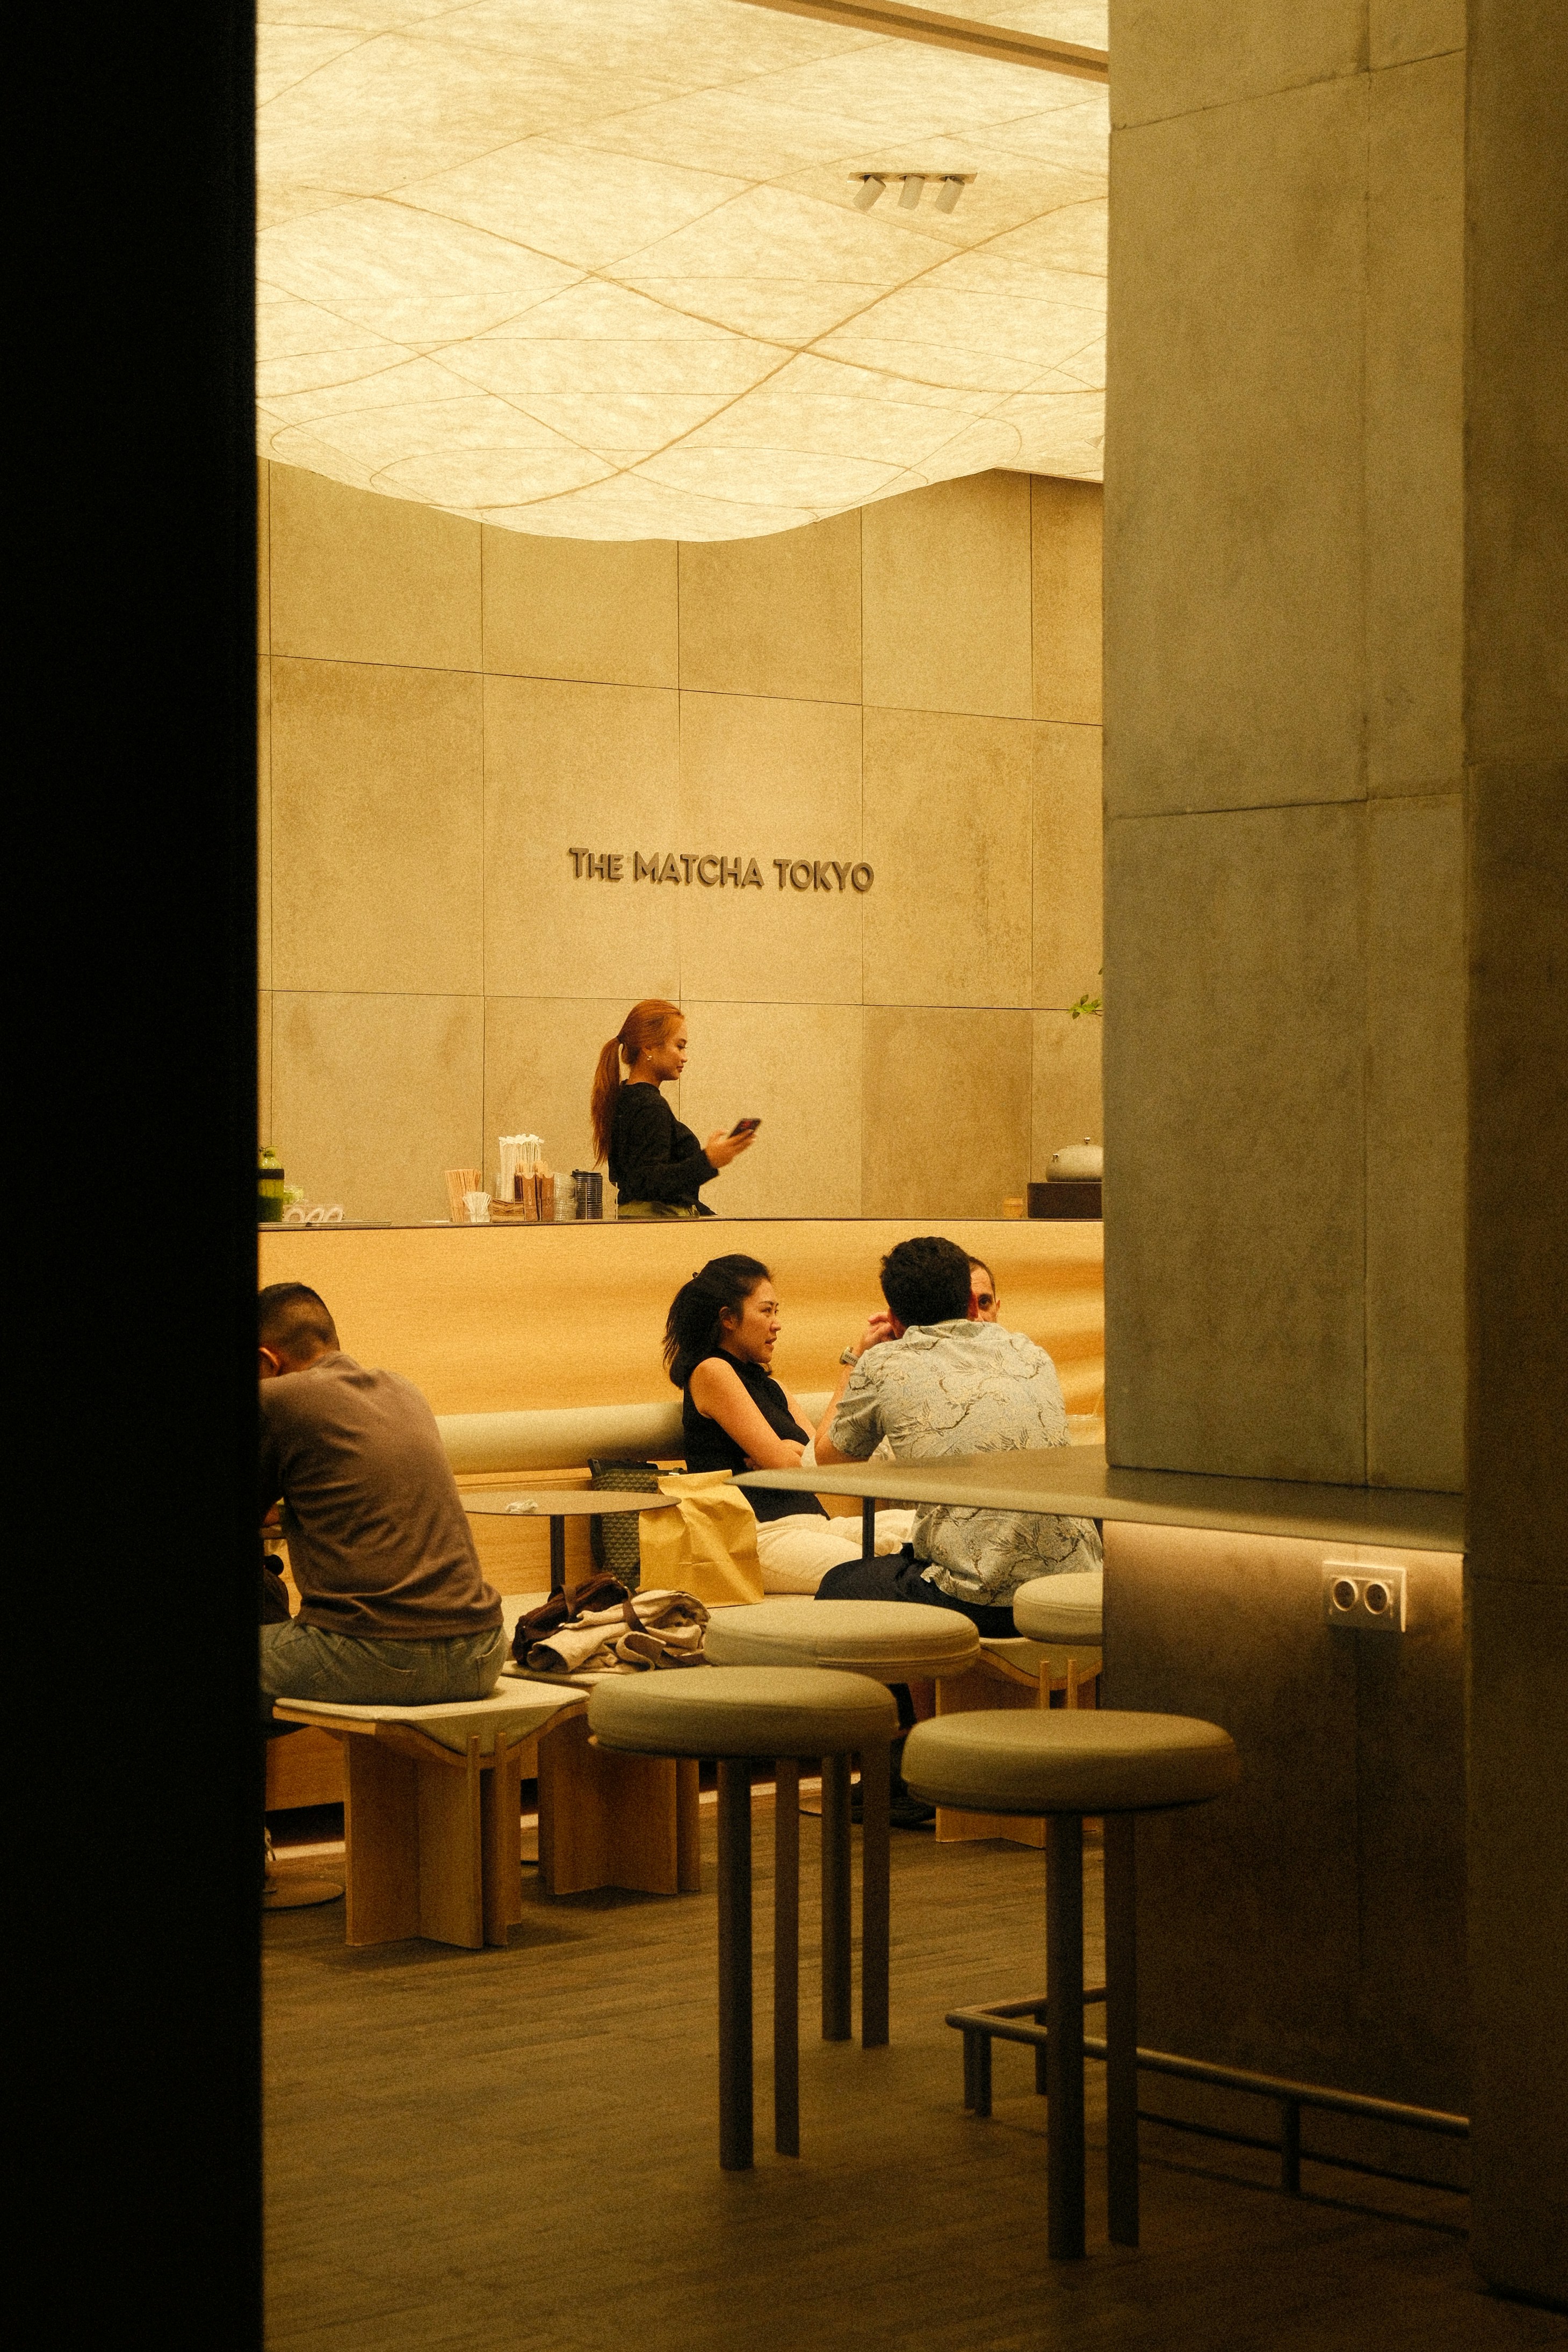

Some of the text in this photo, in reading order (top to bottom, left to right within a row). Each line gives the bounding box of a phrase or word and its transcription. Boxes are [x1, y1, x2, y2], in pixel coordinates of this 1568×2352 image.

[569, 847, 874, 892] THE MATCHA TOKYO
